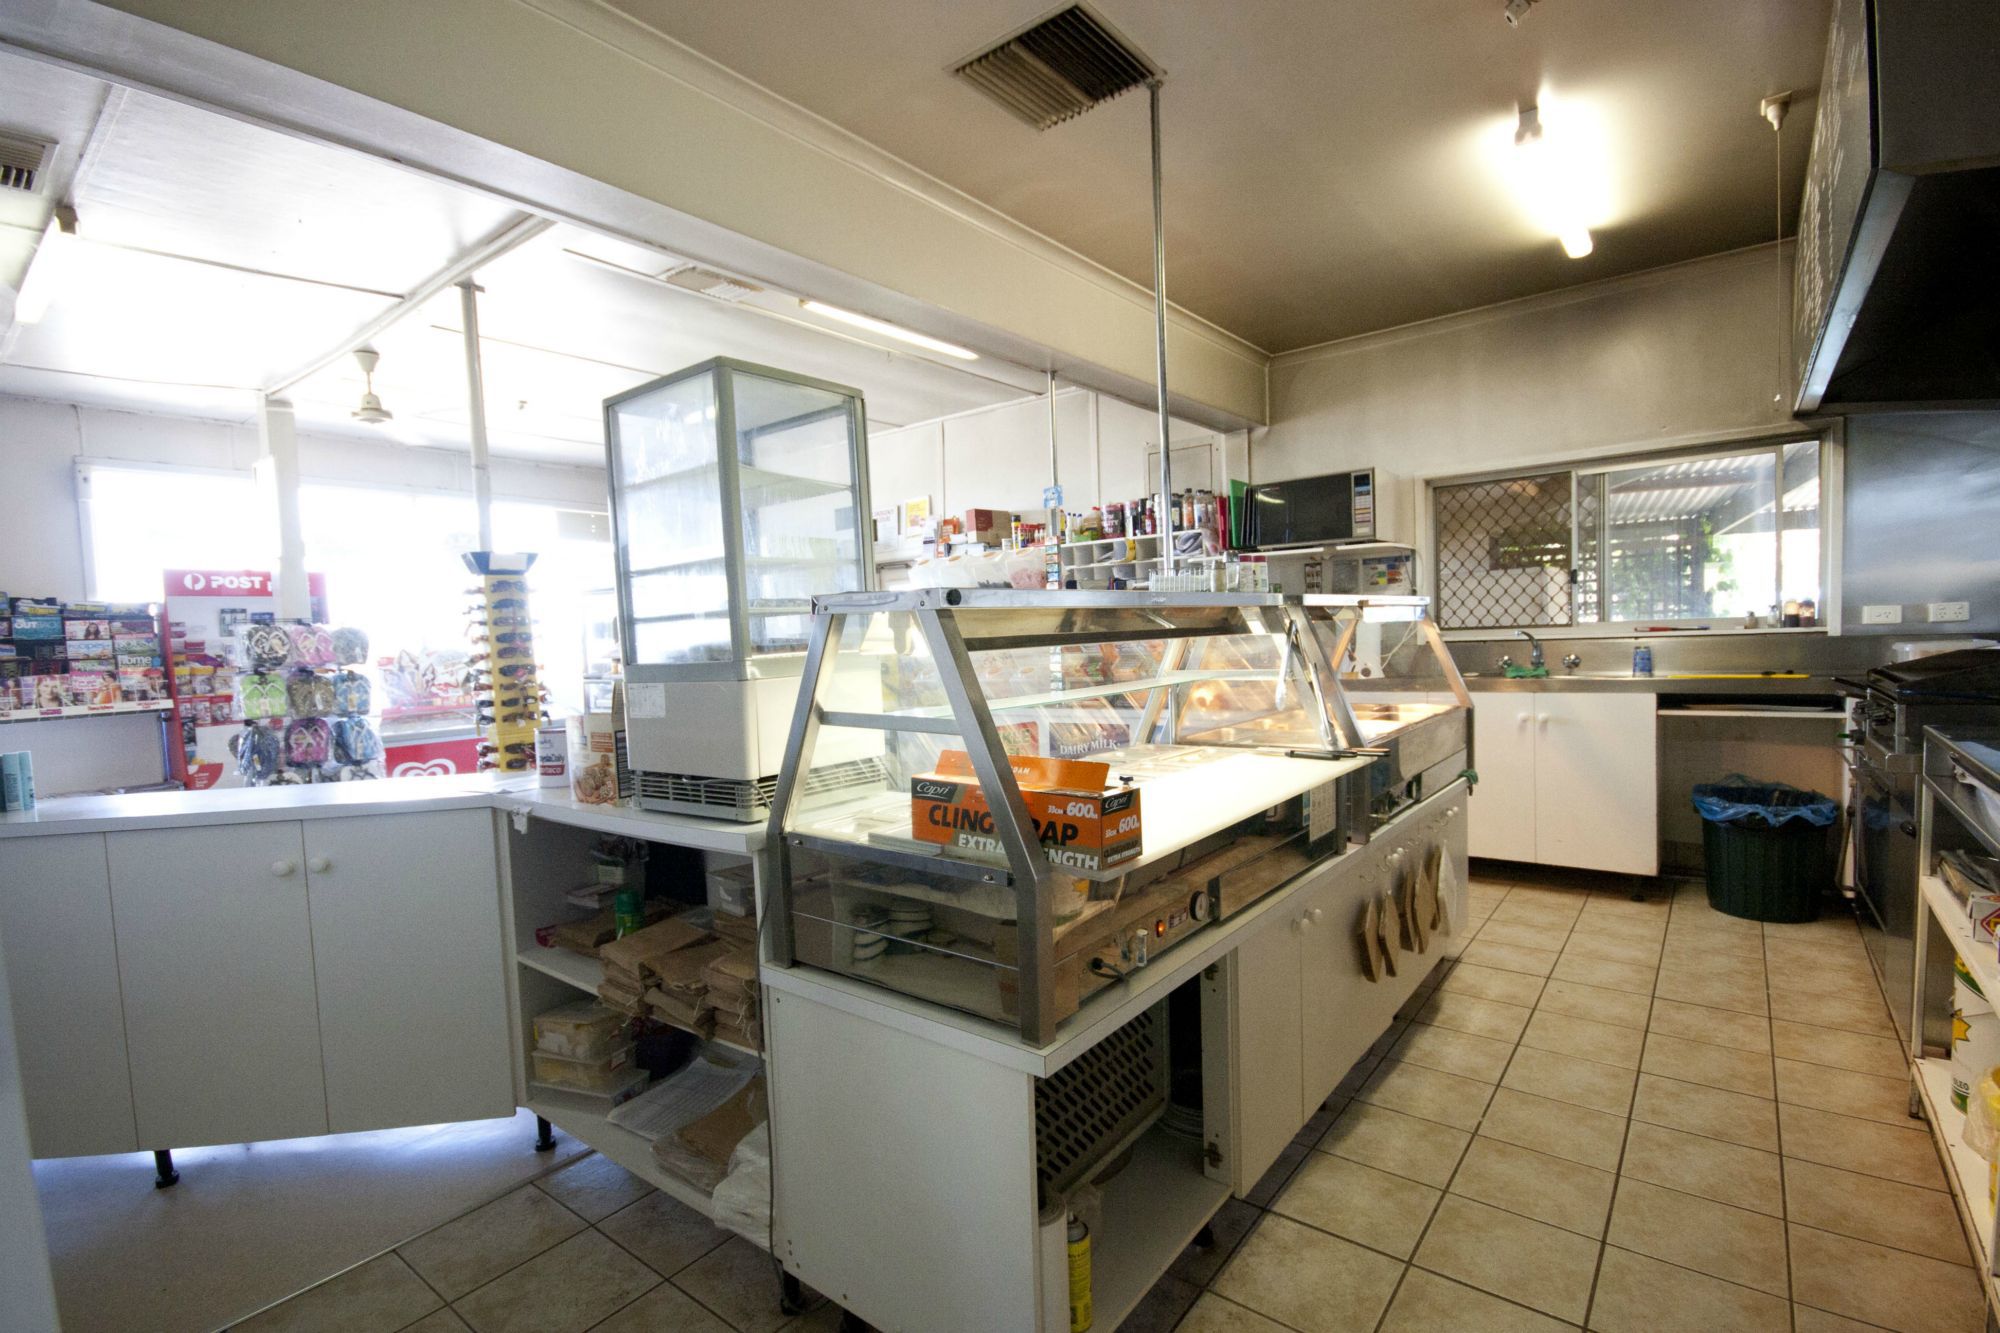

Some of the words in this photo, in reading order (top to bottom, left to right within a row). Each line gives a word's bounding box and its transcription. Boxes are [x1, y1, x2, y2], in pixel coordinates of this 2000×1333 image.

[210, 575, 264, 589] POST
[1060, 742, 1090, 755] DAIRY
[1090, 739, 1118, 750] MILK
[916, 781, 951, 797] Capri
[1105, 794, 1130, 809] Capri
[1044, 847, 1099, 871] NGTH
